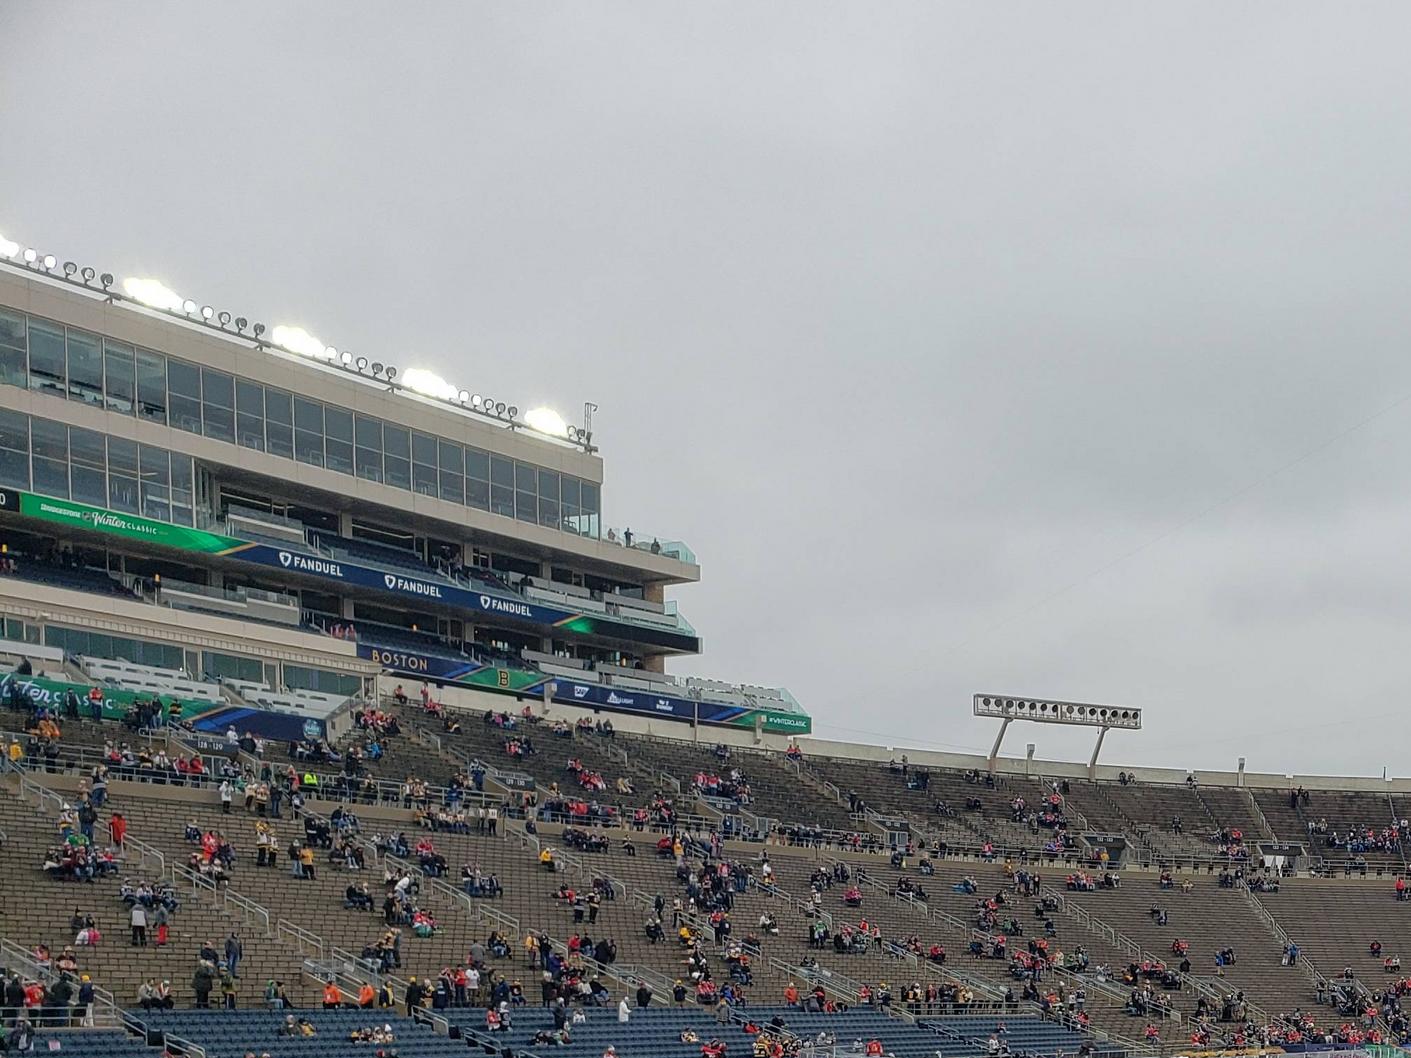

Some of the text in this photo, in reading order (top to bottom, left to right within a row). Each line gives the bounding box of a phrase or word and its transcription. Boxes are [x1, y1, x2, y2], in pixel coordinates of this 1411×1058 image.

[91, 511, 126, 529] Winter
[126, 523, 157, 535] CLASSIC
[294, 556, 343, 577] FANDUEL
[397, 579, 442, 598] FANDUEL
[491, 599, 532, 617] FANDUEL
[372, 650, 428, 671] BOSTON
